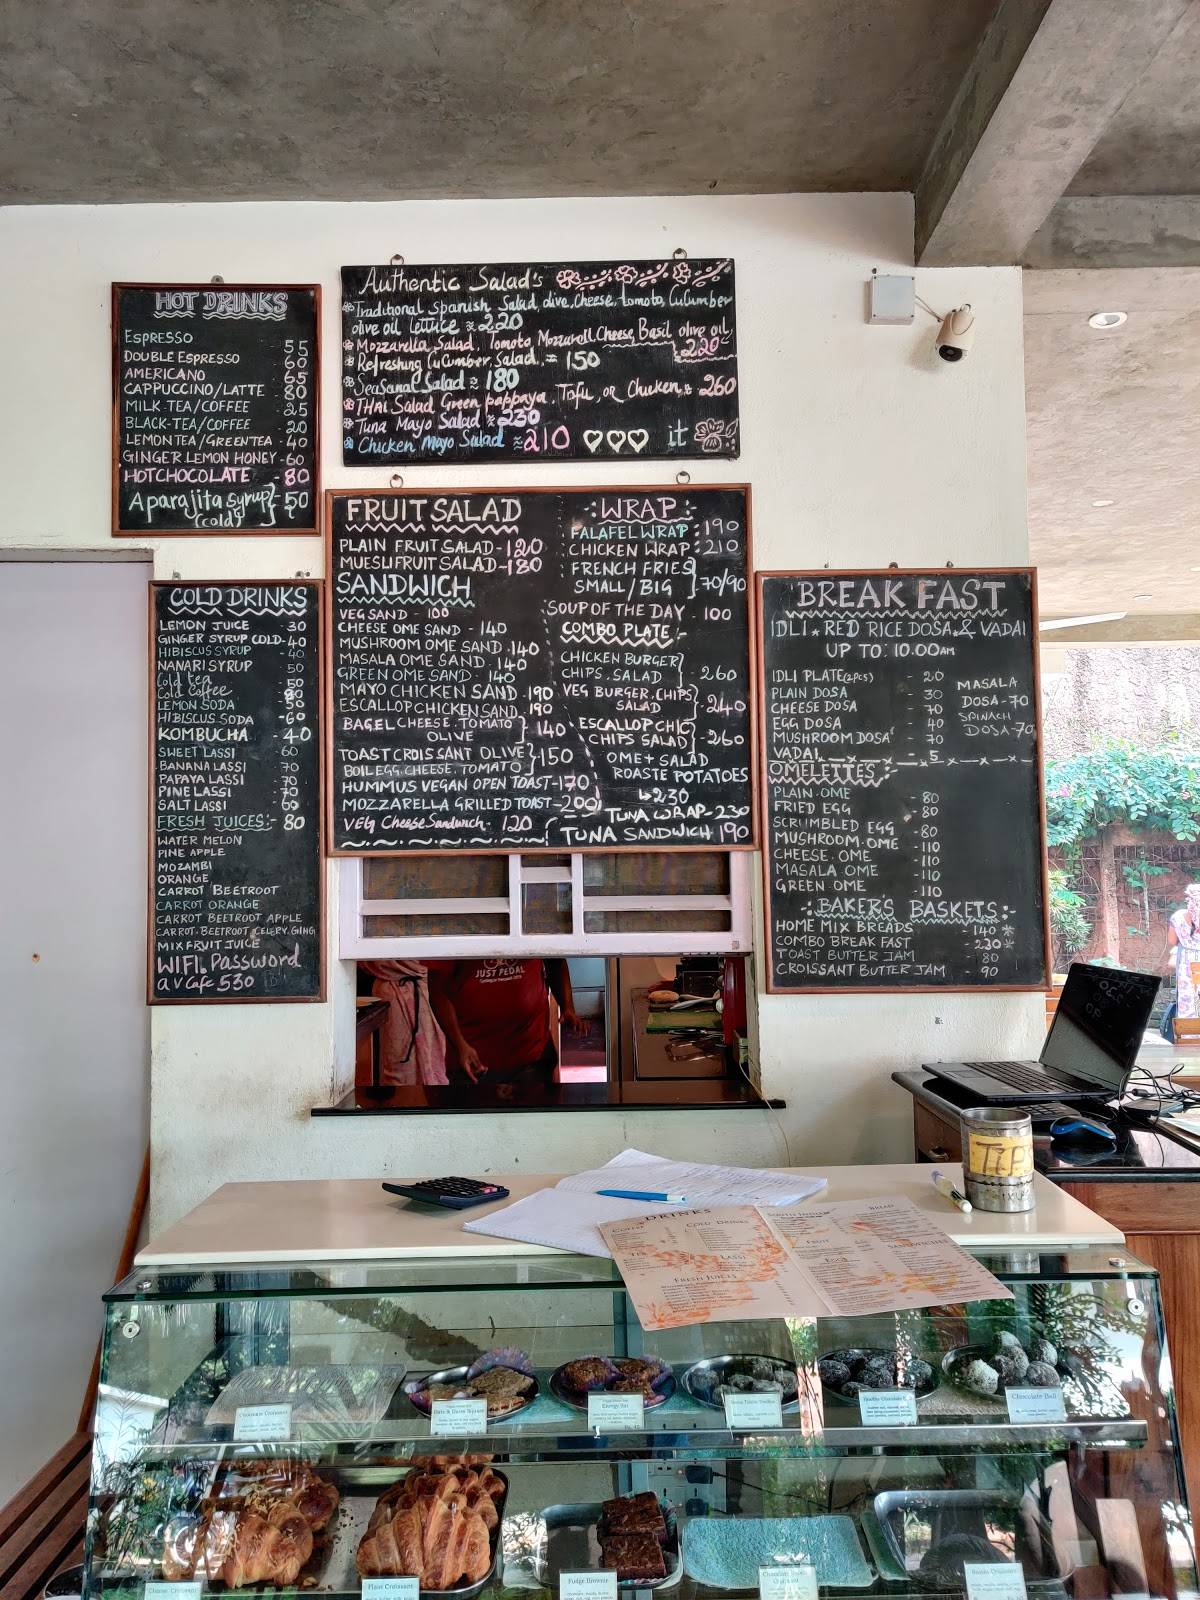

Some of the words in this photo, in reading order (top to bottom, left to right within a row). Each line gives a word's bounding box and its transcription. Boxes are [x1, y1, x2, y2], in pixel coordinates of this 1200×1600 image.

[359, 266, 460, 294] Authentic
[155, 291, 199, 310] HOT
[203, 292, 288, 313] DRINKS
[284, 340, 308, 357] 55
[124, 352, 174, 362] DOUBLE
[284, 358, 307, 369] 60
[567, 351, 600, 370] 150
[125, 368, 205, 381] AMERICANO
[284, 370, 308, 384] 65
[486, 368, 520, 392] 180
[284, 385, 307, 400] 80
[699, 374, 736, 396] 260
[391, 395, 435, 414] Salad
[441, 393, 481, 409] Green
[286, 421, 307, 433] 20
[358, 418, 386, 434] Tuna
[396, 417, 432, 438] Mayo
[438, 410, 481, 429] Salad
[497, 409, 540, 427] 230
[524, 426, 570, 451] 210
[128, 490, 222, 522] Aparajita
[284, 491, 308, 509] 50
[601, 497, 677, 519] WRAP
[348, 499, 427, 521] FRUIT
[430, 498, 521, 522] SALAD
[571, 526, 637, 539] FALAFEL
[641, 525, 688, 538] WRAP
[706, 518, 739, 535] 190
[339, 539, 386, 552] PLAIN
[395, 539, 439, 552] FRUIT
[441, 540, 494, 554] SALAD
[507, 538, 543, 557] 120
[569, 543, 637, 557] CHICKEN
[645, 542, 691, 557] WRAP
[703, 539, 738, 555] 210
[572, 562, 636, 575] FRENCH
[643, 560, 693, 575] FRIES
[336, 572, 471, 599] SANDWICH
[171, 588, 222, 606] COLD
[227, 587, 307, 607] DRINKS
[798, 580, 905, 608] BREAK
[918, 579, 1005, 610] FAST
[340, 609, 365, 619] VEG
[368, 609, 407, 620] SAND
[428, 608, 449, 618] 100
[547, 600, 588, 616] SOUP
[591, 603, 611, 615] OF
[615, 604, 644, 617] THE
[651, 604, 685, 622] DAY
[704, 607, 731, 620] 100
[160, 620, 205, 630] LEMON
[212, 621, 249, 630] JUICE
[287, 622, 306, 631] 30
[338, 622, 387, 633] CHEESE
[393, 623, 419, 635] OME
[425, 624, 461, 636] SAND
[481, 621, 507, 636] 140
[562, 622, 616, 636] COMBO
[625, 624, 670, 639] PLATE
[824, 619, 860, 637] RED
[866, 621, 902, 638] RICE
[908, 620, 951, 637] DOSA
[158, 635, 204, 644] GINGER
[210, 635, 248, 644] SYRUP
[252, 635, 281, 644] COLD
[288, 636, 306, 647] 40
[158, 661, 205, 672] NANARI
[208, 661, 253, 672] SYRUP
[561, 652, 620, 664] CHICKEN
[625, 654, 678, 668] BURGER
[700, 666, 737, 681] 260
[341, 683, 386, 695] MAYO
[391, 684, 466, 699] CHICKEN
[471, 684, 517, 700] SAND
[529, 687, 553, 700] 190
[772, 687, 807, 699] PLAIN
[813, 686, 847, 698] DOSA
[924, 689, 943, 700] 30
[706, 694, 746, 716] 240
[771, 702, 820, 713] CHEESE
[825, 700, 857, 713] DOSA
[924, 704, 943, 715] 70
[343, 718, 395, 731] BAGEL
[397, 717, 450, 728] CHEESE
[459, 717, 512, 728] TOMATO
[537, 721, 565, 737] 140
[158, 728, 248, 741] KOMBUCHA
[283, 727, 311, 744] 40
[427, 732, 474, 741] OLIVE
[589, 734, 635, 745] CHIPS
[642, 734, 687, 749] SALAD
[707, 730, 744, 745] 260
[160, 762, 210, 770] BANANA
[214, 762, 246, 772] LASSI
[281, 762, 299, 772] 70
[674, 768, 748, 783] POTATOES
[770, 763, 875, 778] OMELETTES
[342, 780, 417, 793] HUMMUS
[422, 778, 468, 793] VEGAN
[473, 777, 506, 790] OPEN
[510, 776, 552, 789] TOAST
[343, 799, 449, 811] MOZZARELLA
[455, 798, 511, 811] GRILLED
[516, 797, 552, 809] TOAST
[158, 816, 205, 827] FRESH
[284, 814, 305, 830] 80
[605, 808, 649, 823] TUNA
[714, 805, 749, 820] 230
[560, 826, 617, 845] TUNA
[624, 824, 710, 841] SANDWICH
[720, 822, 748, 843] 190
[776, 864, 837, 876] MASALA
[844, 865, 878, 877] OME
[158, 886, 204, 896] CARROT
[213, 885, 279, 895] BEETROOT
[910, 900, 998, 918] BASKETS
[776, 919, 814, 932] HOME
[821, 920, 849, 933] MIX
[857, 920, 913, 933] BREADS
[475, 968, 496, 978] JUST
[499, 965, 525, 976] PEDAL
[777, 963, 855, 976] CROISSANT
[860, 964, 912, 976] BUTTER
[916, 965, 945, 977] JAM
[981, 966, 998, 977] 90
